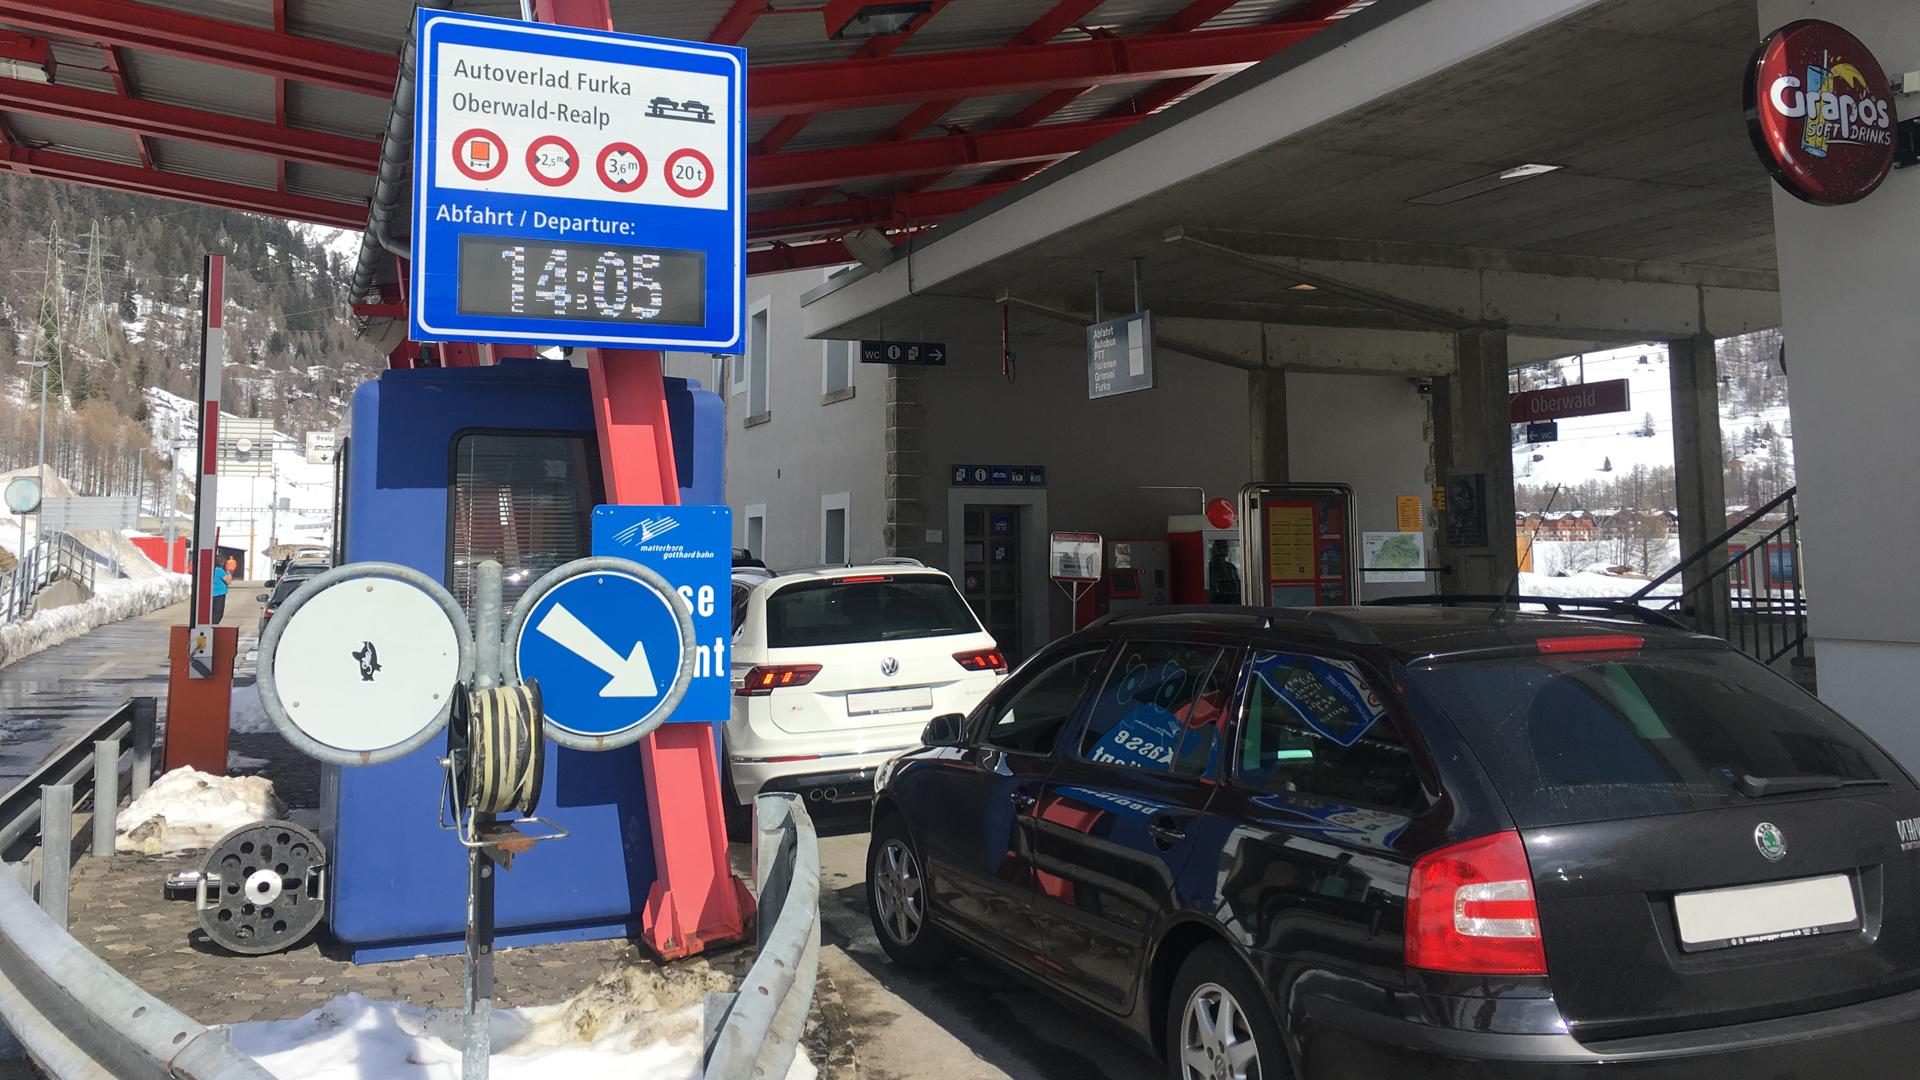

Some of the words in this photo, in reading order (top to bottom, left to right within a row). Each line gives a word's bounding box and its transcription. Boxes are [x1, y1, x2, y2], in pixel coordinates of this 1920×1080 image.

[453, 59, 570, 90] Autoverlad
[577, 72, 632, 96] Furka
[452, 92, 611, 131] Oberwald-Realp
[1770, 76, 1890, 139] Grapos
[1807, 121, 1841, 138] SOFT
[1850, 124, 1891, 146] DRINKS
[436, 204, 514, 227] Abfahrt
[533, 211, 635, 235] Departure:
[502, 246, 663, 320] 14:05
[864, 351, 880, 360] WC
[1531, 388, 1597, 414] Oberwald
[1541, 432, 1552, 440] WC
[640, 543, 684, 552] matterhorn
